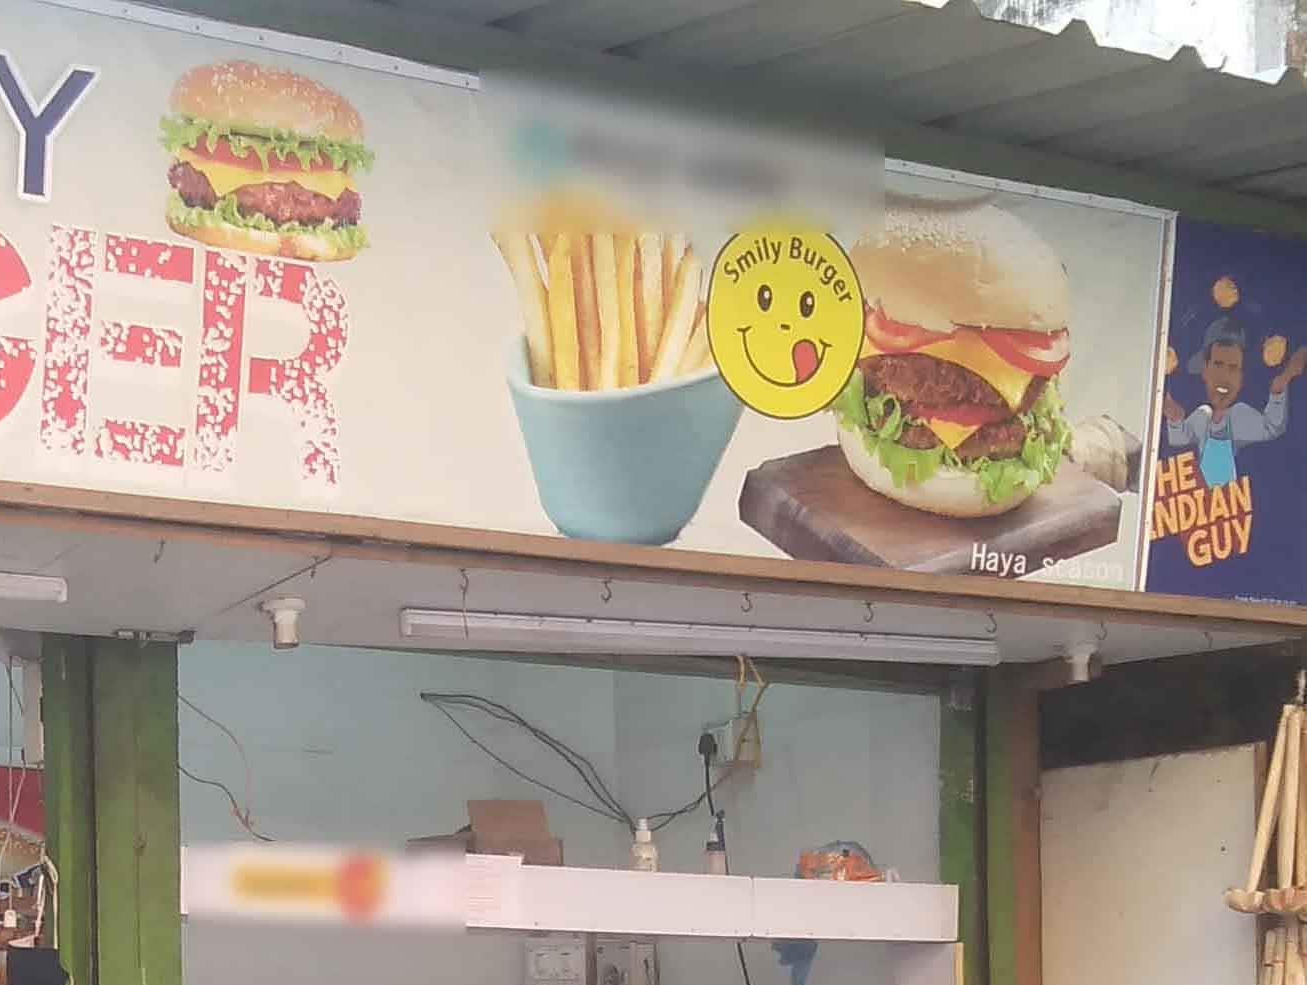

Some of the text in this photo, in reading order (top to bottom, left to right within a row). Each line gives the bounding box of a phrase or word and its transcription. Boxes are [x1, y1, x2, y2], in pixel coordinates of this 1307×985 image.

[723, 236, 853, 304] Smily Burger
[1156, 451, 1197, 497] HE
[1149, 475, 1252, 541] NDIAN
[970, 542, 1026, 577] Haya
[1187, 514, 1253, 567] GUY
